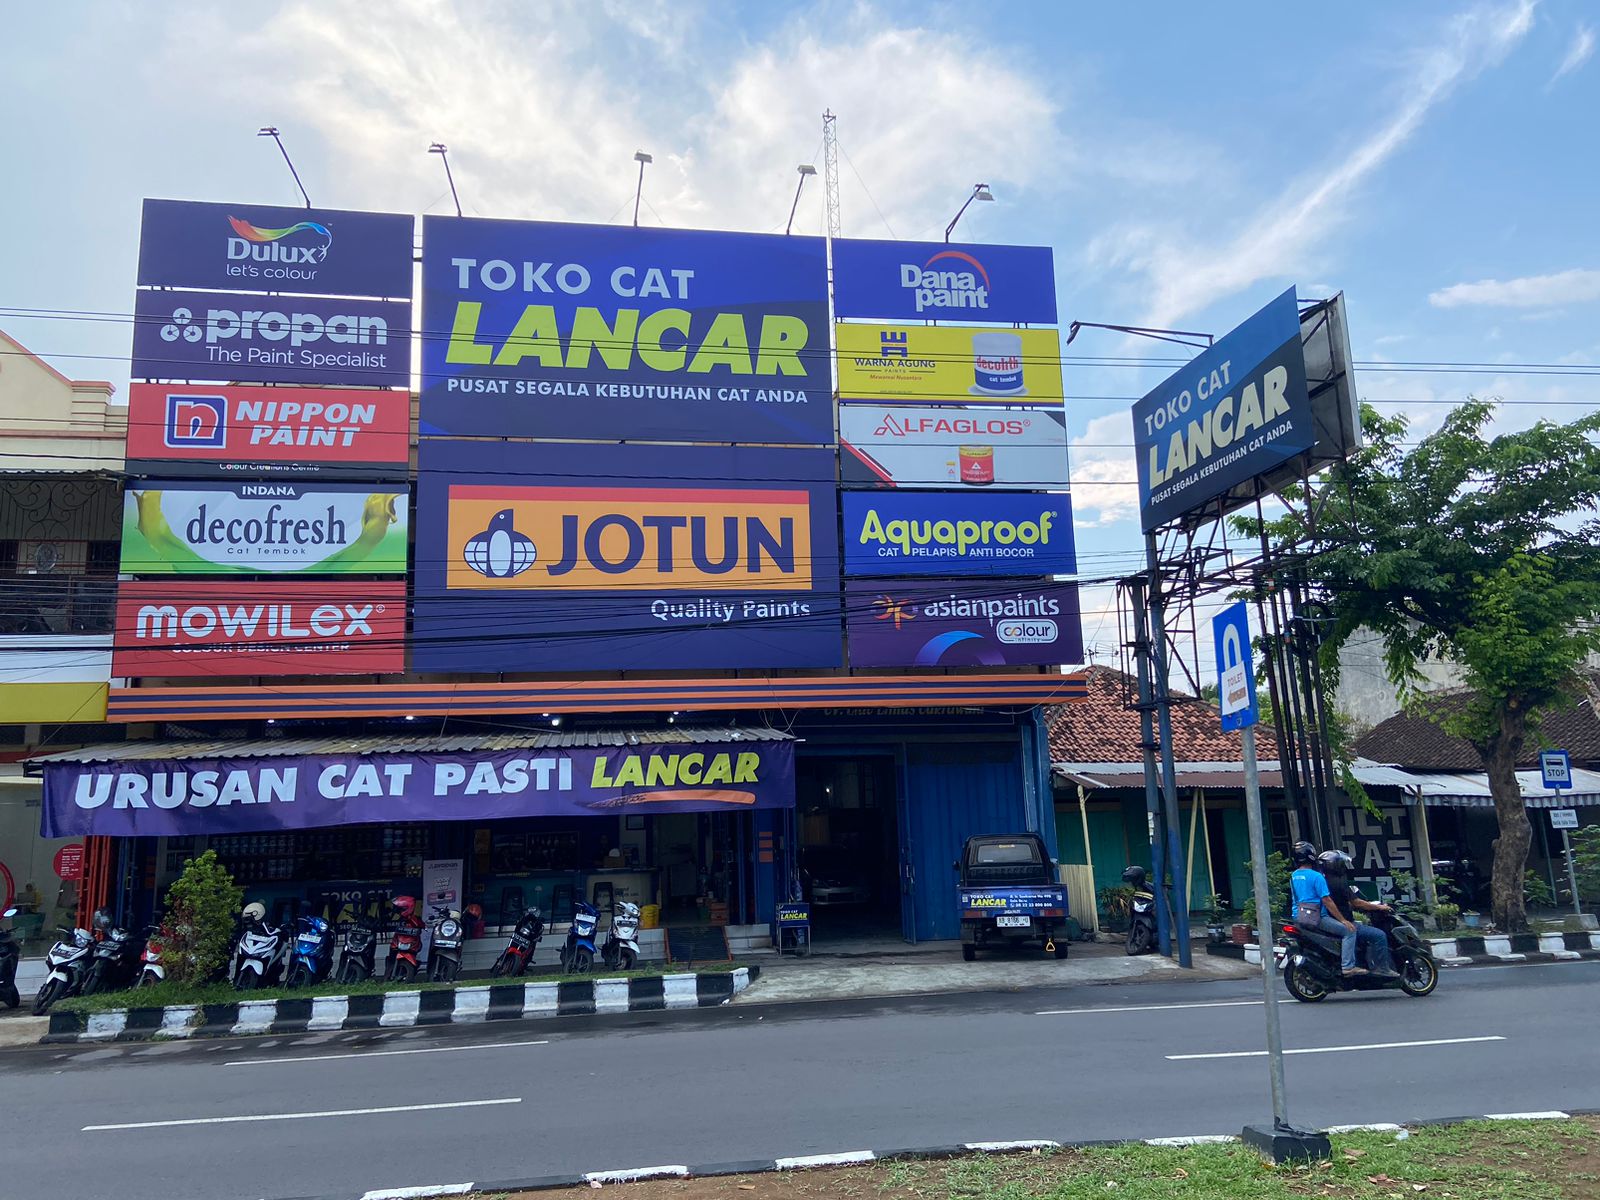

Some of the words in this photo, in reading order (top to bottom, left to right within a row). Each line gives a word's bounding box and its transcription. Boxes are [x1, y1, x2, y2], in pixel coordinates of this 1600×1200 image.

[227, 236, 317, 264] Dulux
[226, 263, 259, 278] let's
[263, 266, 318, 281] colour
[451, 257, 591, 295] TOKO
[610, 265, 695, 300] CAT
[901, 263, 976, 290] Dana
[915, 285, 989, 312] paint
[206, 307, 388, 347] propan
[445, 300, 809, 377] LANCAR
[206, 346, 242, 363] The
[248, 347, 295, 364] Paint
[300, 350, 386, 368] Specialist
[854, 358, 895, 368] WARNA
[897, 359, 936, 369] AGUNG
[447, 378, 509, 394] PUSAT
[515, 380, 590, 397] SEGALA
[595, 383, 712, 401] KEBUTUHAN
[717, 388, 749, 402] CAT
[755, 389, 808, 403] ANDA
[1144, 389, 1192, 437] TOKO
[1197, 360, 1232, 401] CAT
[235, 400, 376, 424] NIPPON
[249, 425, 361, 448] PAINT
[873, 413, 1024, 437] ALFAGLOS
[1149, 365, 1291, 490] LANCAR
[1151, 487, 1172, 506] PUSAT
[1172, 472, 1199, 495] SEGALA
[1200, 447, 1248, 480] KEBUTUHAN
[1248, 435, 1265, 452] CAT
[1266, 420, 1293, 441] ANDA
[242, 485, 296, 497] INDANA
[186, 503, 347, 545] decofresh
[859, 509, 1053, 556] Aquaproof
[227, 547, 250, 555] Cat
[257, 547, 307, 556] Tembok
[546, 513, 795, 576] JOTUN
[877, 547, 899, 557] CAT
[911, 547, 957, 557] PELAPIS
[969, 548, 994, 557] ANTI
[995, 548, 1035, 557] BOCOR
[650, 598, 736, 622] Quality
[742, 599, 811, 619] Paints
[923, 593, 1060, 628] asianpaints
[1003, 622, 1051, 638] colour
[1227, 671, 1243, 688] TOILET
[74, 767, 298, 810] URUSAN
[317, 763, 413, 800] CAT
[434, 757, 573, 796] PASTI
[590, 752, 761, 789] LANCAR
[1547, 768, 1566, 777] STOP
[970, 898, 1007, 906] LANCAR
[780, 912, 808, 920] LANCAR
